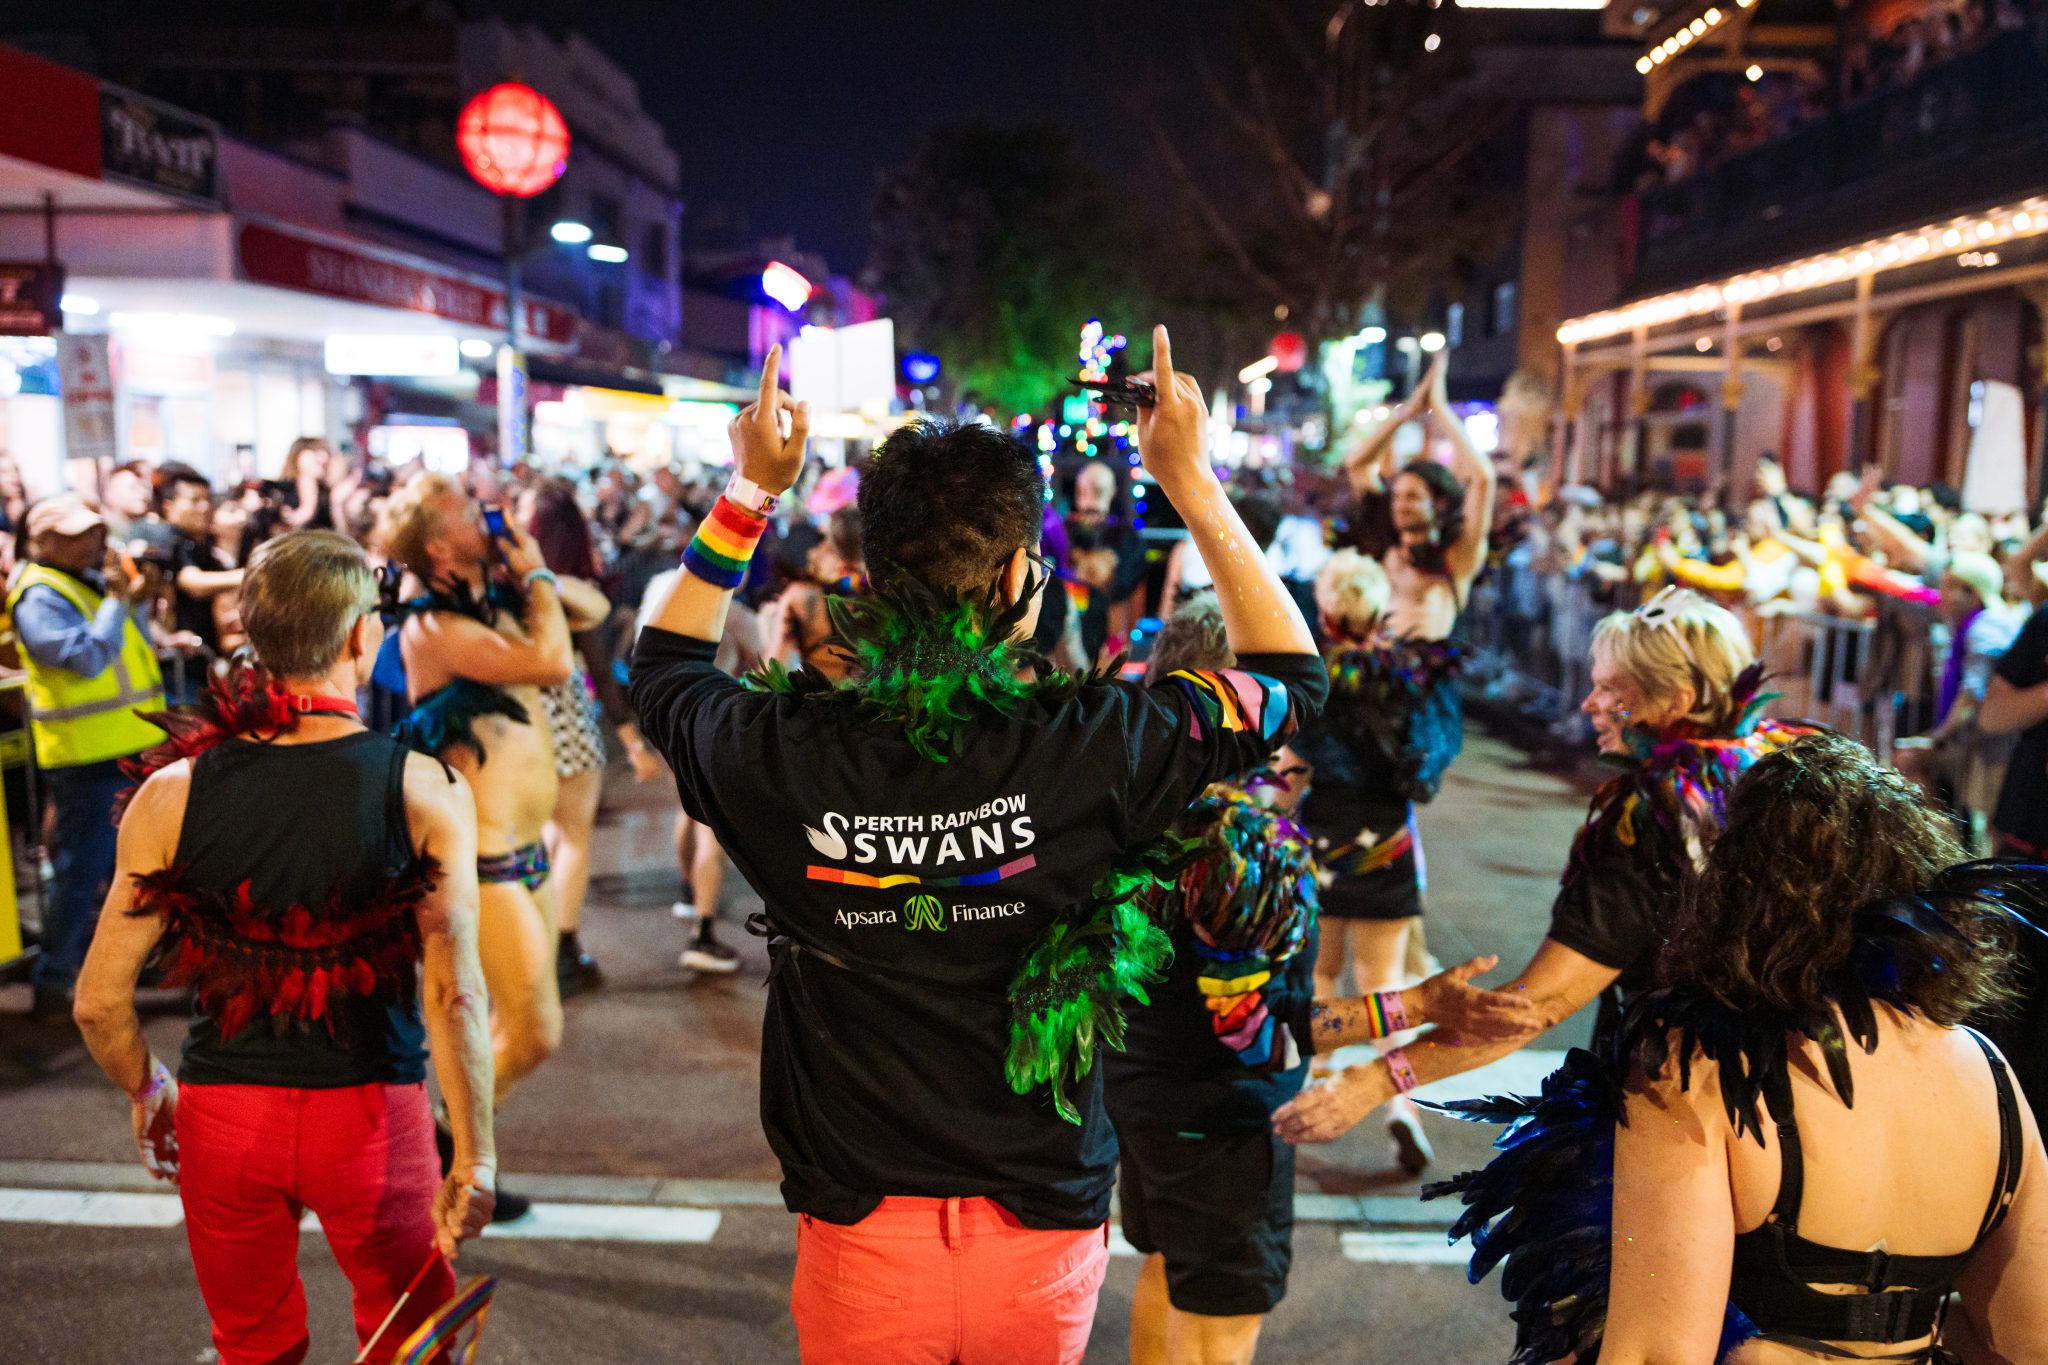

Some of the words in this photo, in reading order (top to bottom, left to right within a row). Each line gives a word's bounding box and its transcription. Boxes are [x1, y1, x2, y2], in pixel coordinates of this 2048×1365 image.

[853, 815, 924, 832] PERTH
[931, 793, 1026, 832] RAINBOW
[854, 816, 1036, 866] SWANS
[834, 908, 897, 930] Apsara
[952, 901, 1026, 923] Finance
